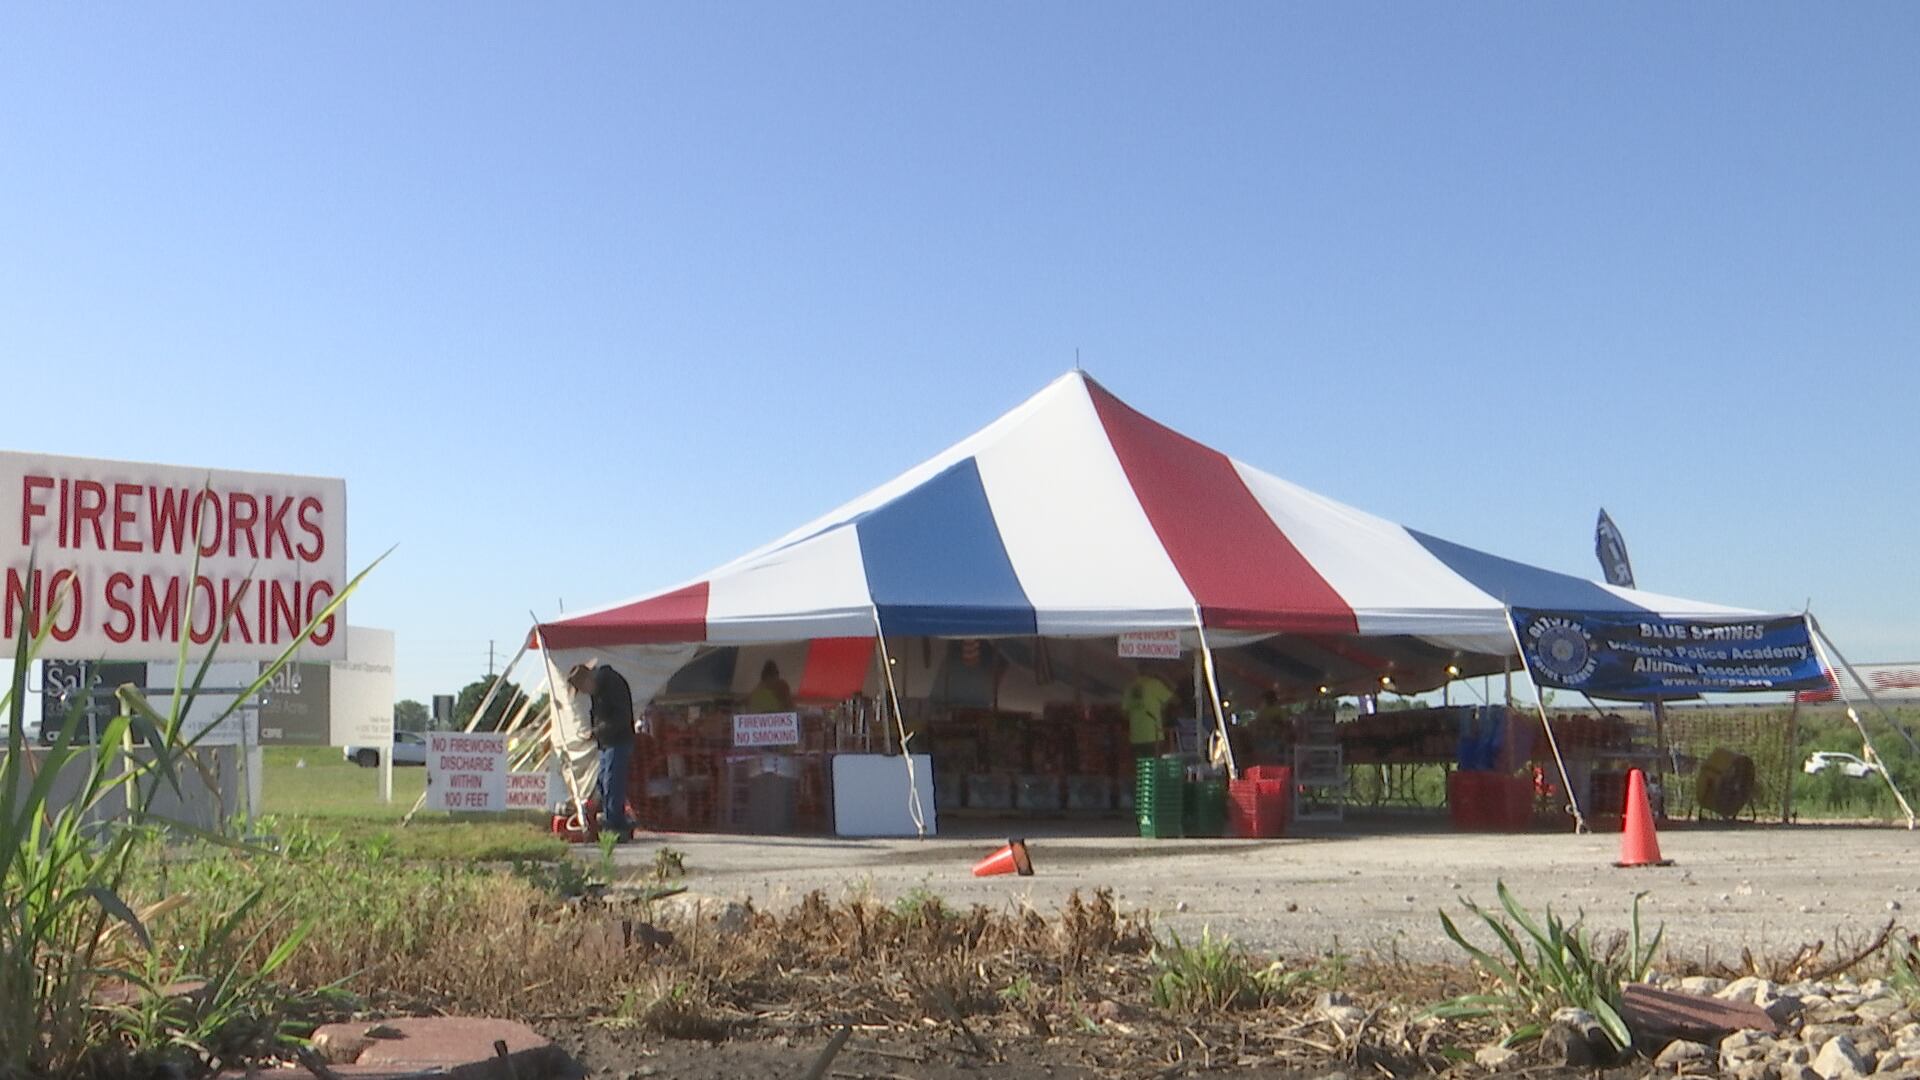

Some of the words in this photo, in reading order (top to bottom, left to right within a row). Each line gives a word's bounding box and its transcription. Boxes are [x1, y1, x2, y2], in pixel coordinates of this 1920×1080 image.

[22, 475, 325, 563] FIREWORKS
[4, 567, 82, 642] NO
[102, 571, 336, 647] SMOKING
[1640, 623, 1686, 639] BLUE
[1690, 625, 1764, 640] SPRINGS
[1121, 643, 1135, 655] NO
[1137, 643, 1178, 656] SMOKING
[1677, 646, 1728, 661] Police
[1732, 644, 1808, 661] Academy
[1697, 665, 1793, 678] Association
[262, 663, 303, 696] Sale
[739, 714, 794, 728] FIREWORKS
[736, 732, 750, 745] NO
[752, 730, 796, 743] SMOKING
[431, 738, 447, 752] NO
[450, 738, 504, 754] FIREWORKS
[440, 756, 495, 772] DISCHARGE
[450, 775, 483, 788] WITHIN
[445, 792, 462, 806] 100
[465, 792, 489, 806] FEET
[505, 791, 547, 806] MOKING
